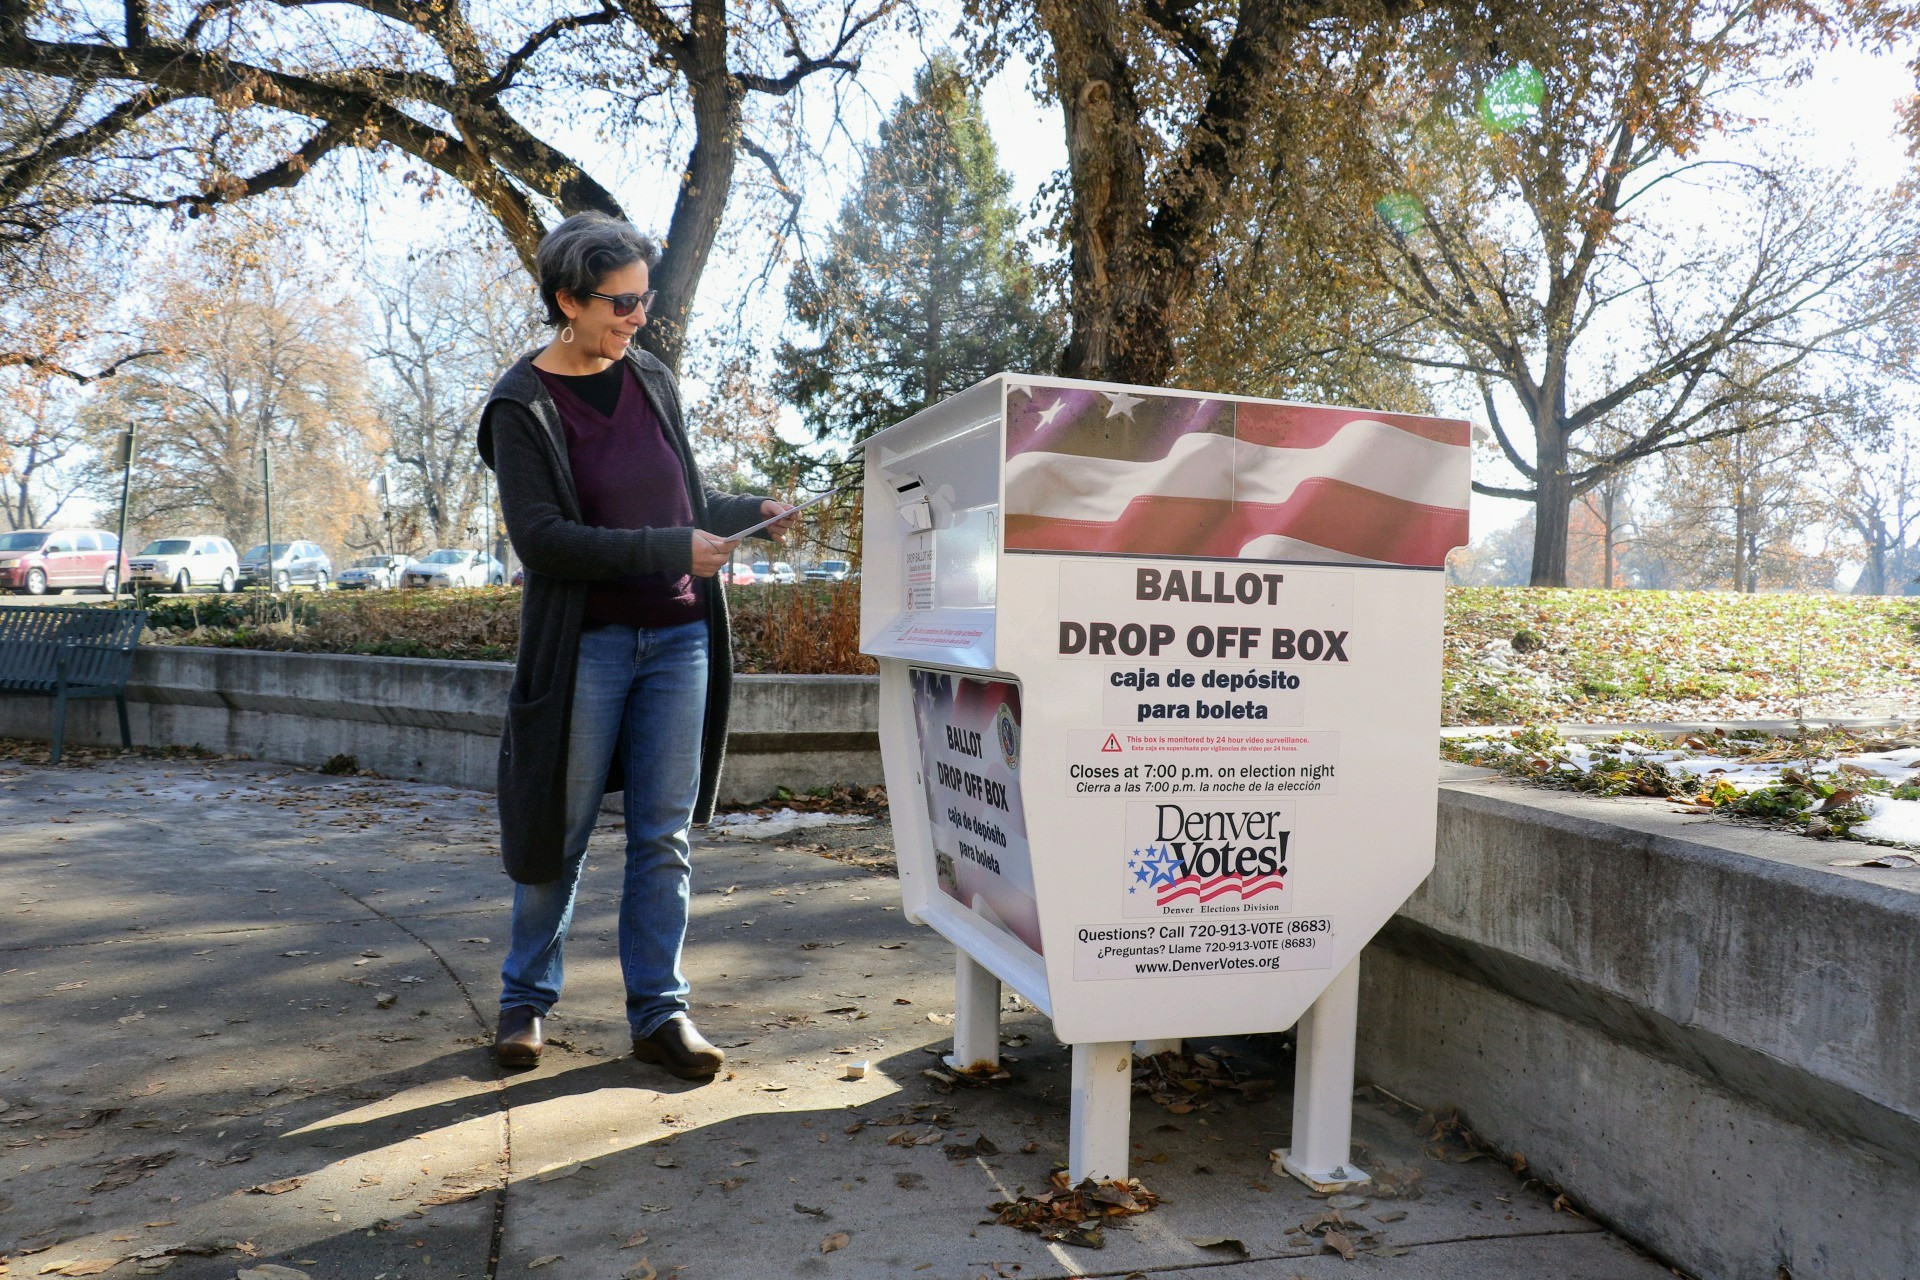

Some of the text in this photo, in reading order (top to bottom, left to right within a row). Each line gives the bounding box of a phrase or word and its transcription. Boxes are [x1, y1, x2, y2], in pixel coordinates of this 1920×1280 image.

[1136, 567, 1284, 605] BALLOT
[1058, 621, 1350, 662] DROP OFF BOX
[1110, 667, 1300, 692] caja de depósito
[1137, 700, 1268, 722] para boleta
[946, 725, 983, 759] BALLOT
[1126, 735, 1142, 743] This
[1070, 764, 1335, 781] Closes at 7:00 p.m. on election night
[937, 761, 1009, 812] DROP OFF BOX
[1076, 780, 1321, 794] Cierra a las 7:00 p.m. la noche de la elección
[948, 806, 1007, 848] caja de depósito
[1155, 804, 1281, 841] Denver
[958, 840, 976, 858] para
[976, 845, 1001, 876] boleta
[1170, 831, 1291, 879] Votes!
[1163, 906, 1194, 914] Denver
[1201, 905, 1240, 913] Elections
[1078, 919, 1331, 943] Questions? Call 720-913-VOTE (8683)
[1097, 937, 1316, 959] ¿Preguntas? Llame 720-913-VOTE (8683)
[1135, 956, 1280, 973] www.DenverVotes.org
